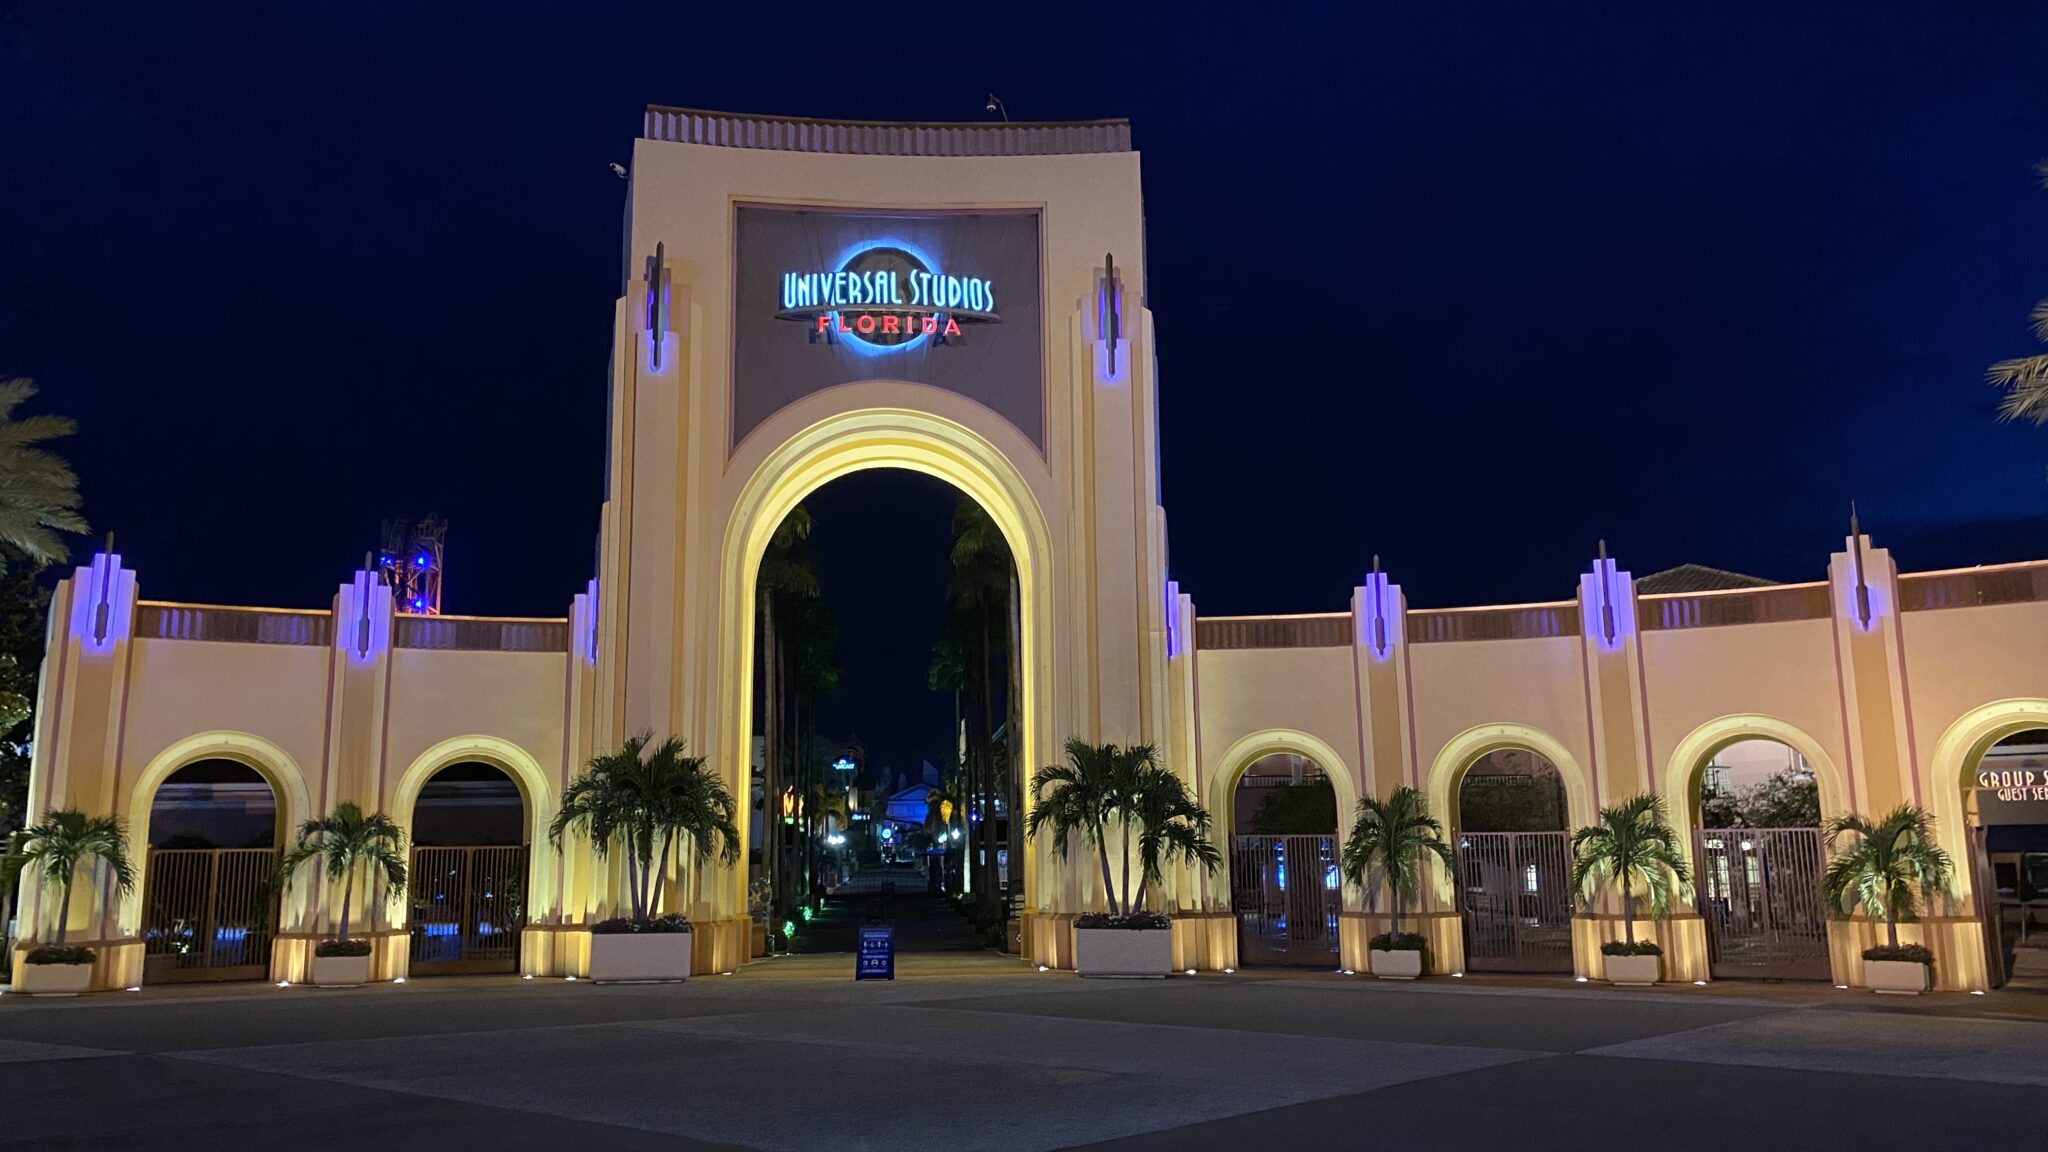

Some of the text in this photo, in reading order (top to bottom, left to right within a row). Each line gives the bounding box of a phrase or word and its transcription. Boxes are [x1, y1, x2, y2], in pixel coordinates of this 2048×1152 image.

[784, 269, 994, 312] UNIVERSAL STUDIOS
[817, 315, 962, 336] FLORIDA
[1979, 771, 2034, 787] GROUP
[1997, 788, 2027, 801] GUEST
